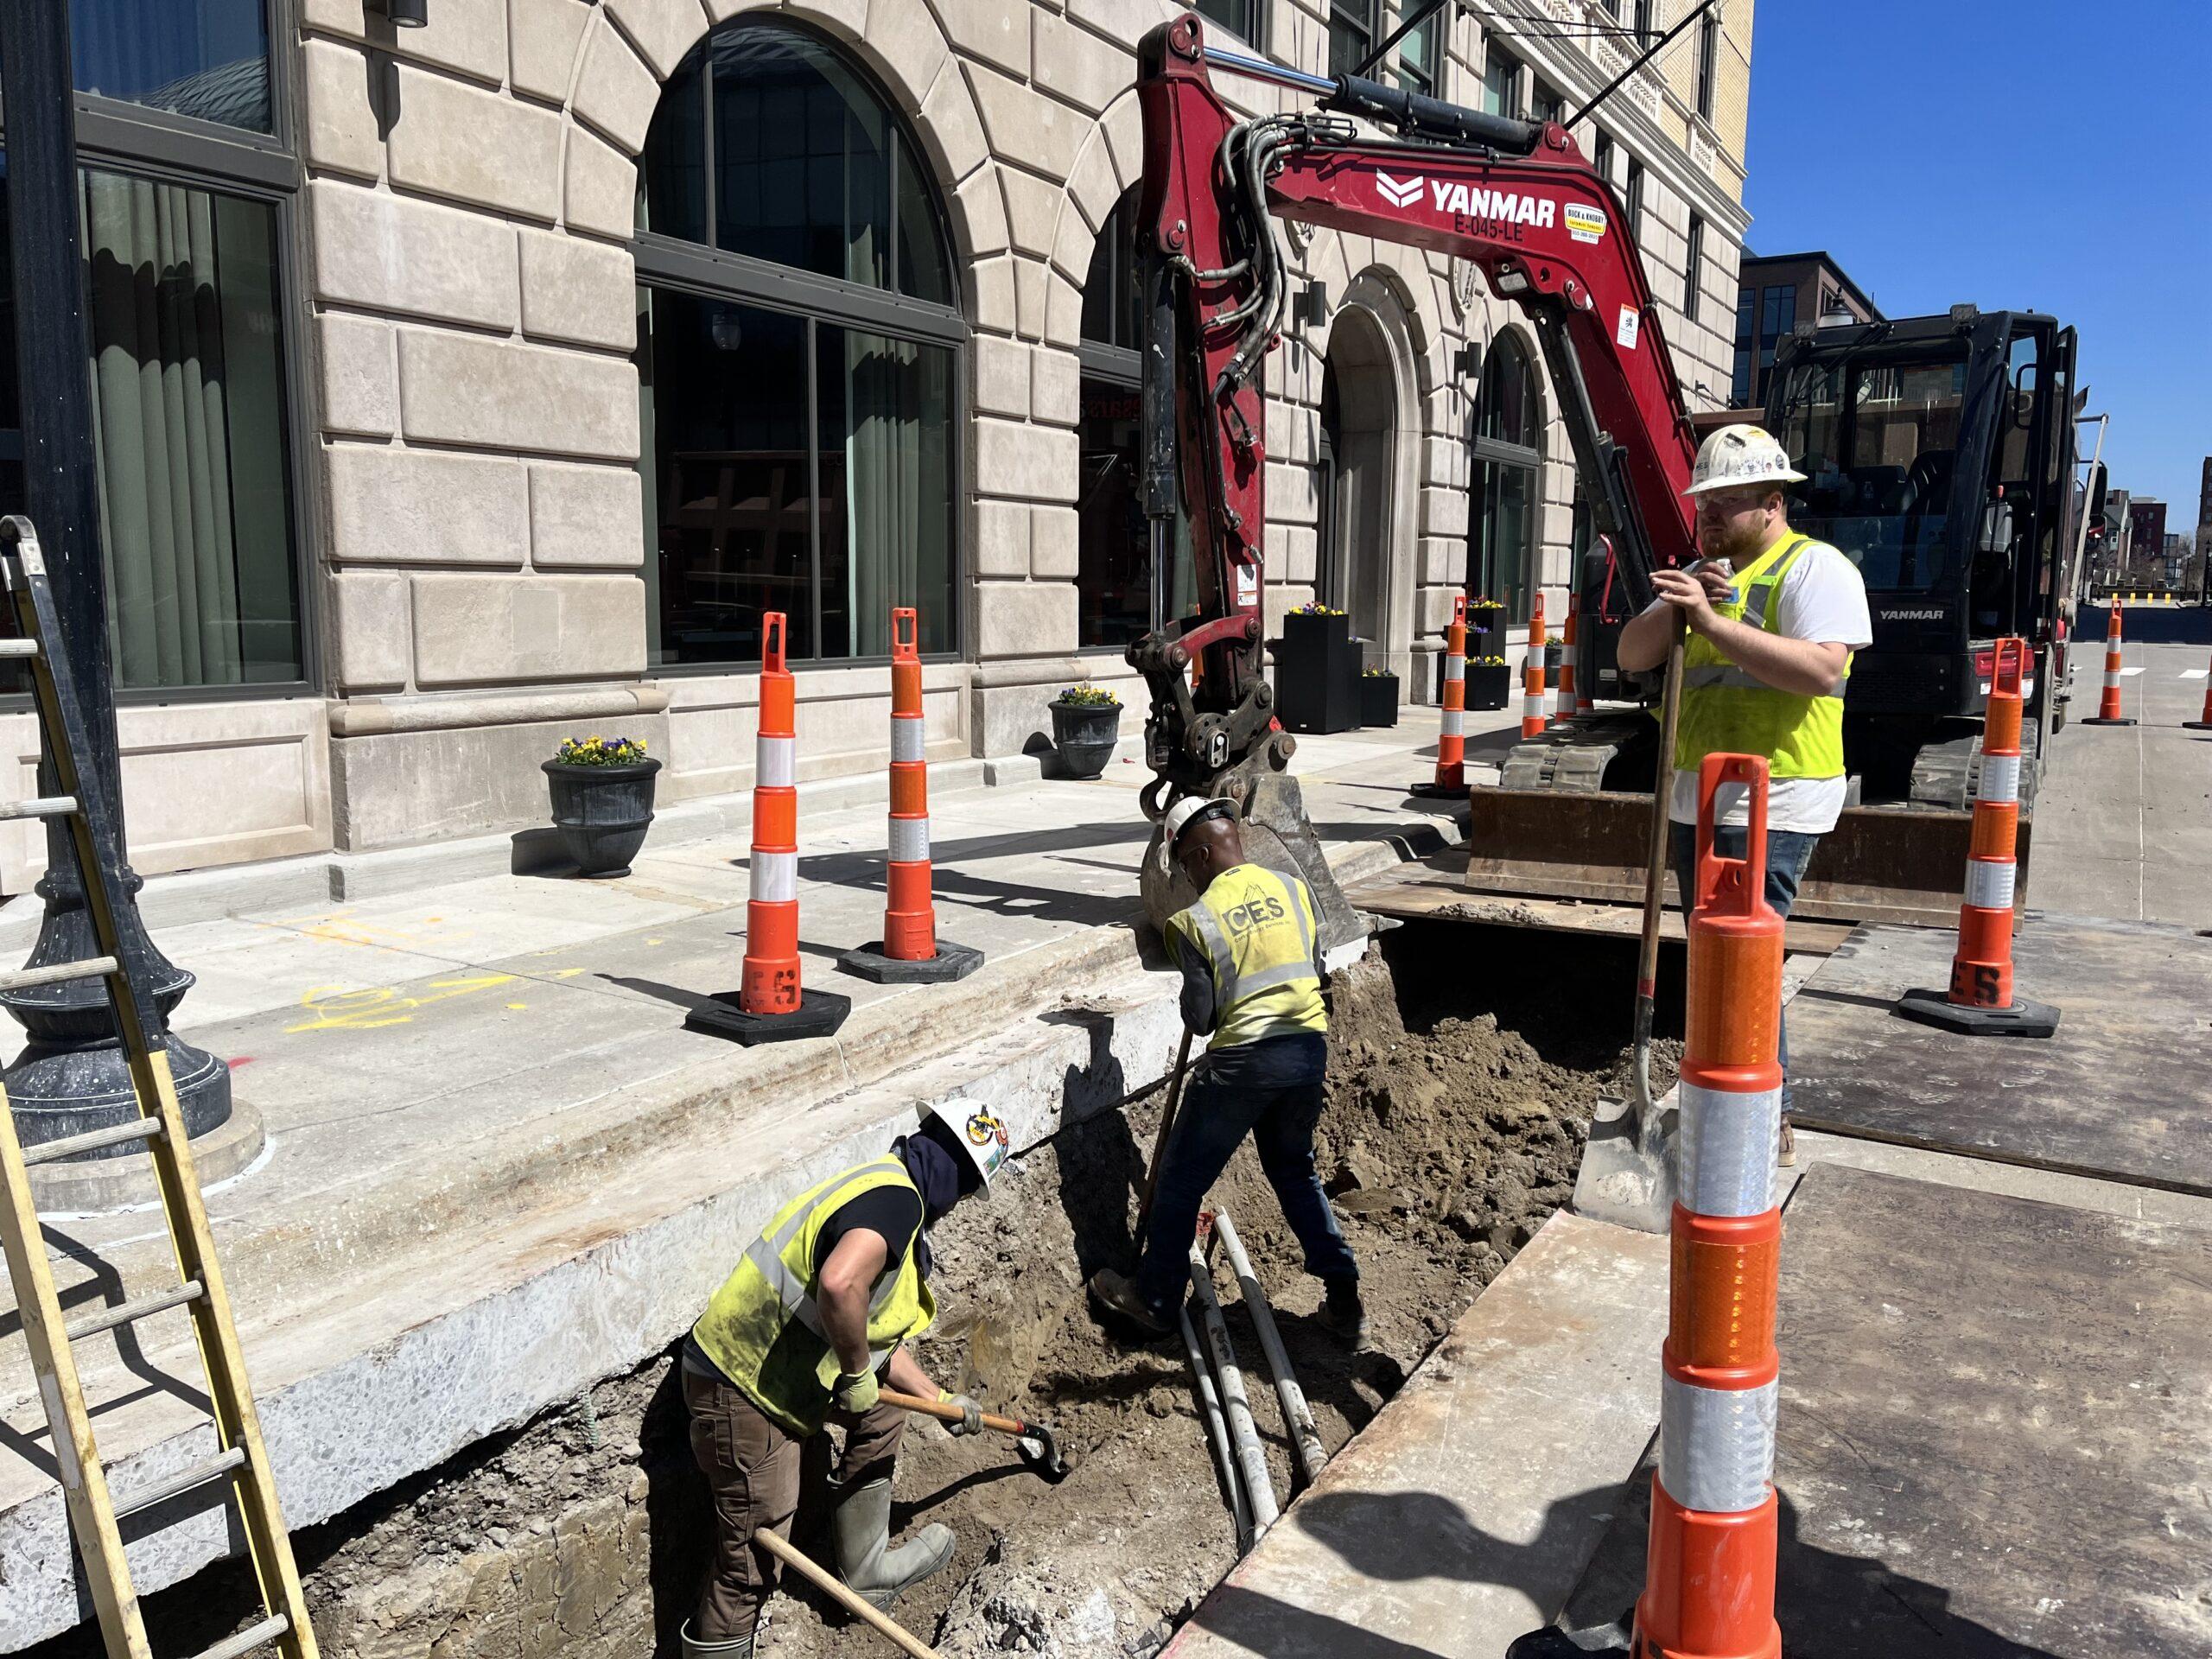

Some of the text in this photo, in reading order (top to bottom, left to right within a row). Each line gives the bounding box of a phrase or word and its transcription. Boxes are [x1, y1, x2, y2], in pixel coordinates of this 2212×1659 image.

[1431, 180, 1555, 228] YANMAR
[1455, 213, 1523, 242] E-045-LE
[1880, 610, 1944, 620] YANMAR
[1225, 897, 1285, 934] CES
